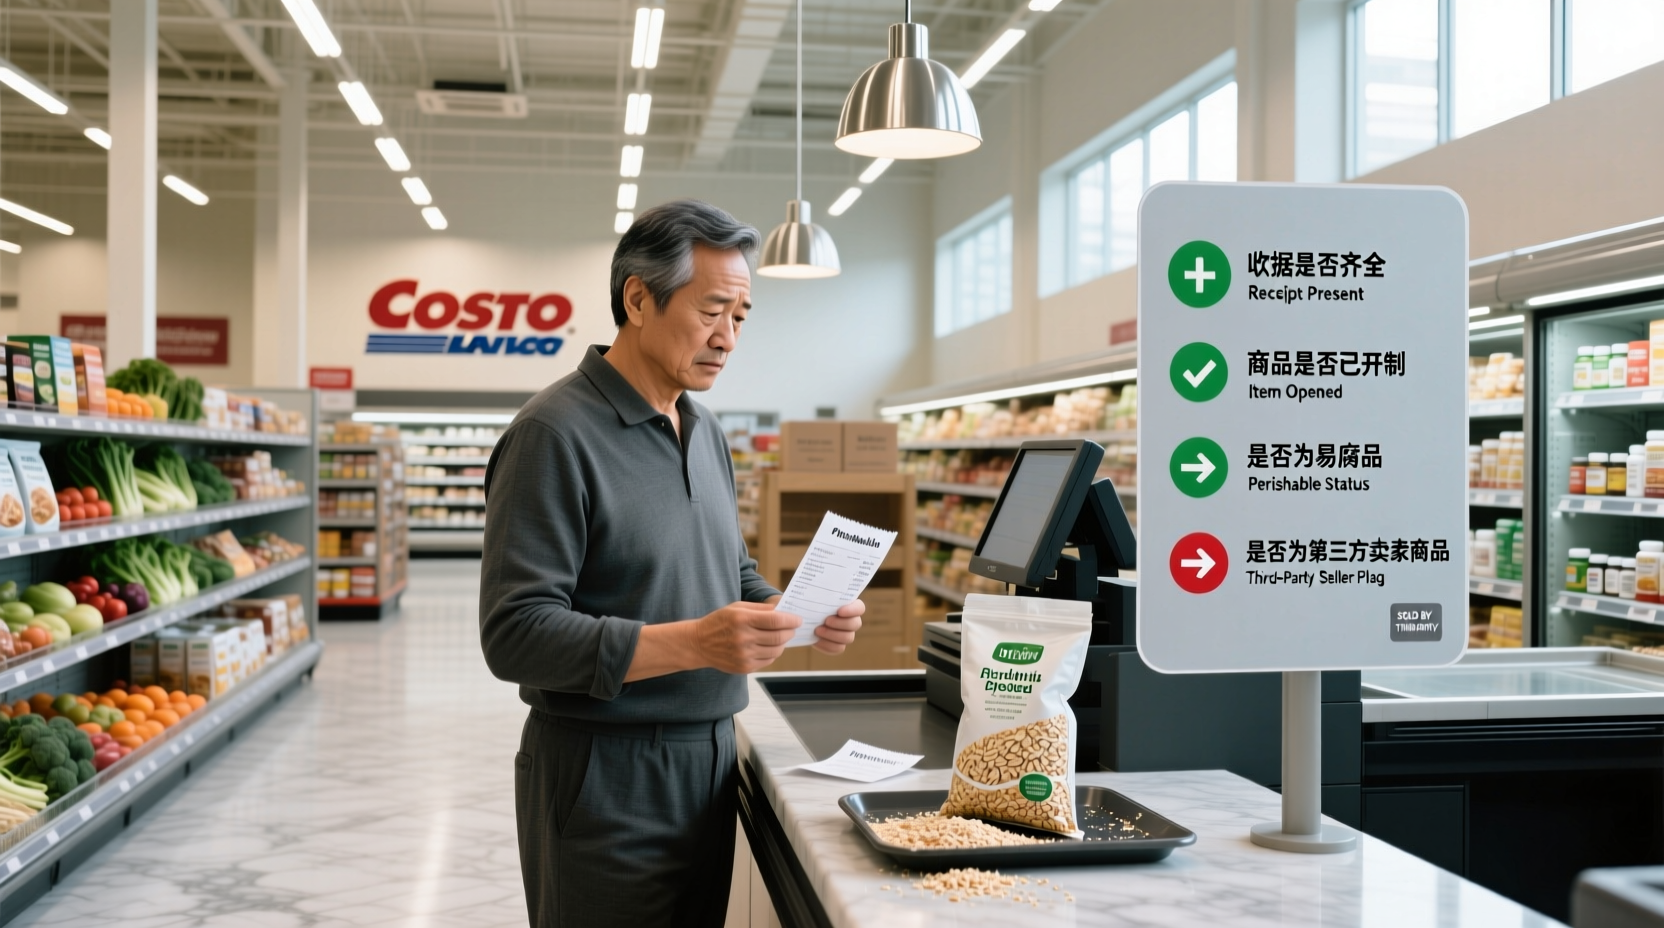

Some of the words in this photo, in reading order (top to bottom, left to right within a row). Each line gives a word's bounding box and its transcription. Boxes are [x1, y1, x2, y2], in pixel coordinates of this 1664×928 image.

[1247, 250, 1386, 278] 收据是否齐全
[1248, 284, 1304, 304] Receipt
[1307, 285, 1365, 301] Present
[1247, 349, 1406, 377] 商品是否已开制
[1249, 383, 1282, 399] Item
[1285, 383, 1343, 403] Opened
[1246, 441, 1383, 468] 是否为易腐品
[1248, 475, 1322, 491] Perishable
[1325, 476, 1370, 491] Status
[1319, 570, 1355, 585] Seller
